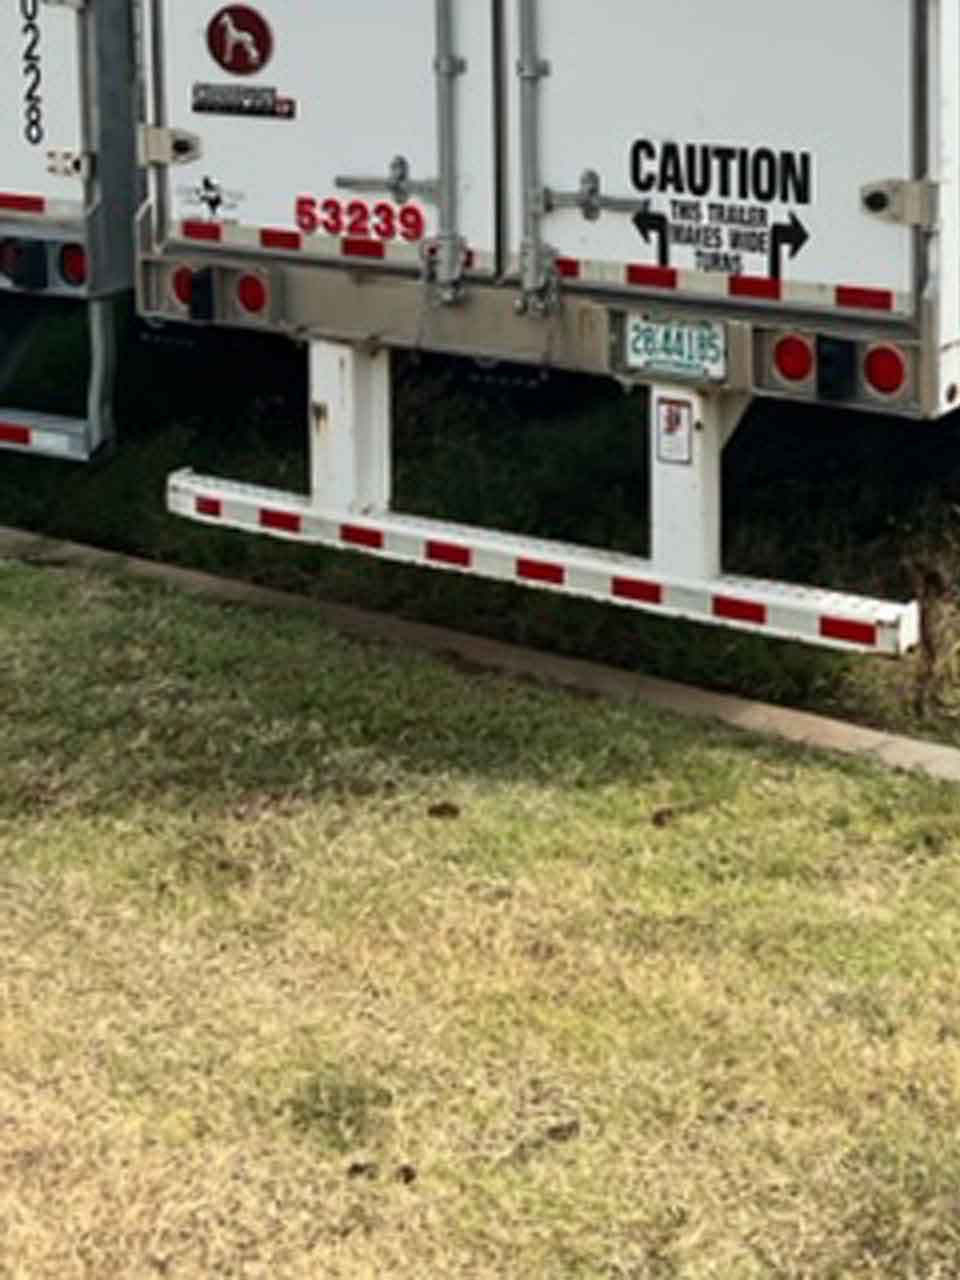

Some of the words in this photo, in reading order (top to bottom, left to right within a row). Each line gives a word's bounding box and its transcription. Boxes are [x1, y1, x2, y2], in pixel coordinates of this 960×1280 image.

[630, 139, 811, 204] CAUTION
[297, 195, 426, 241] 53239
[670, 199, 701, 222] THIS
[708, 202, 768, 227] TRAILER
[668, 224, 722, 249] MAKES
[728, 229, 768, 254] WIDE
[695, 251, 742, 273] TURNS
